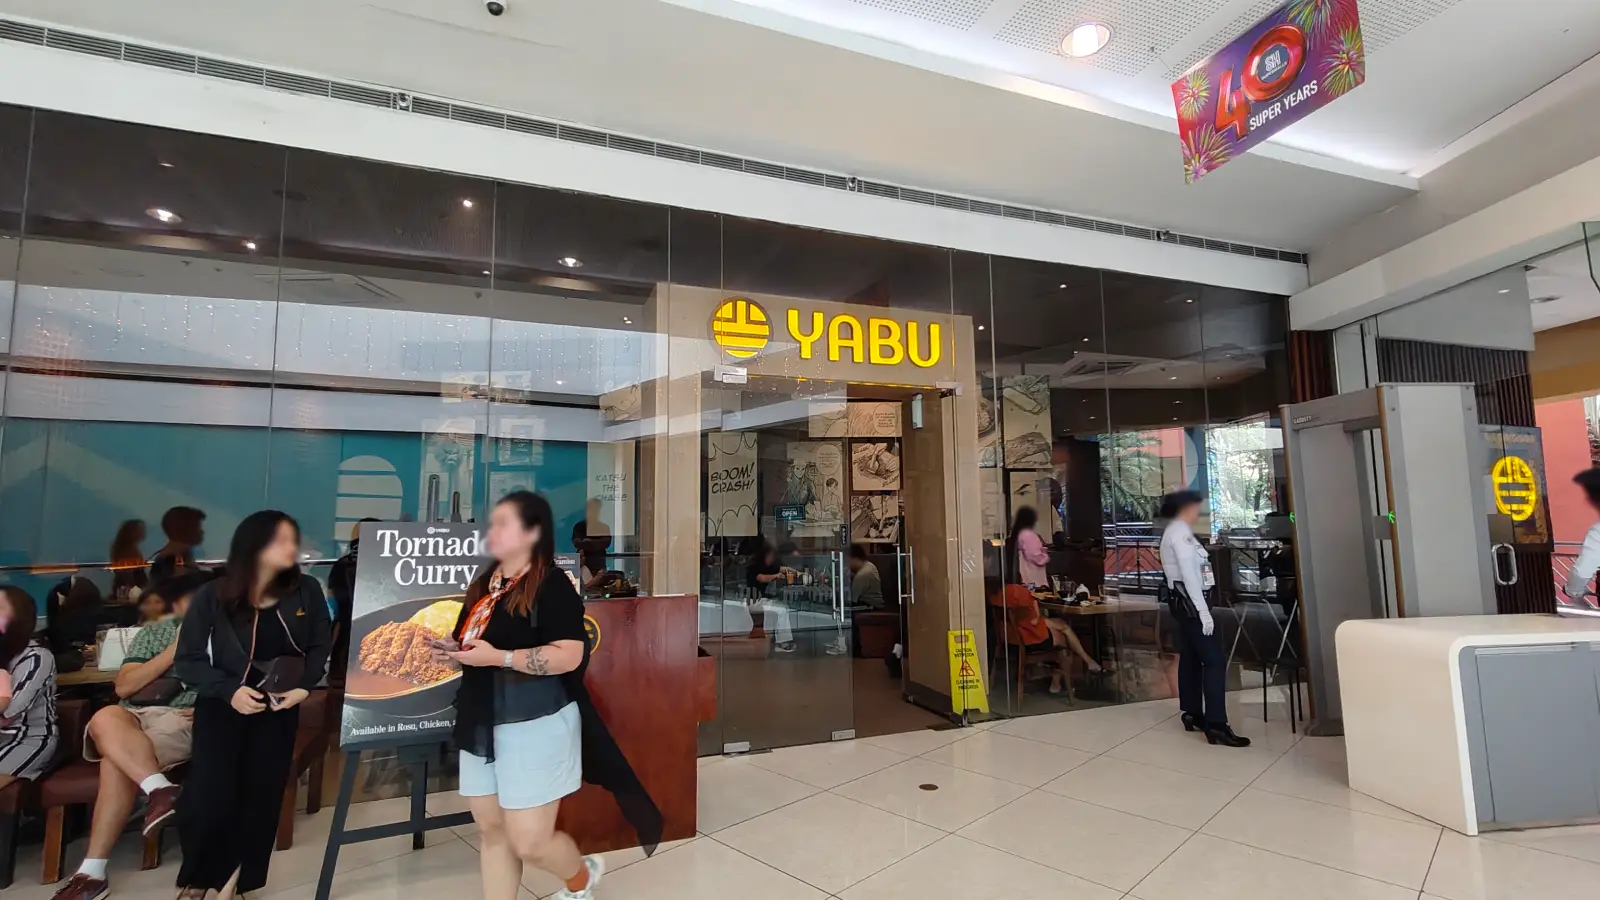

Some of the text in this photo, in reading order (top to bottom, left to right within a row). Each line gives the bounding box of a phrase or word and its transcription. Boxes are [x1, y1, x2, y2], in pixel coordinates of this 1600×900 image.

[1249, 79, 1318, 131] SUPER YEARS
[786, 308, 942, 368] YABU
[595, 473, 627, 483] KATSU
[711, 461, 755, 481] BOOM!
[602, 484, 621, 492] THE
[711, 479, 755, 494] CRASH!
[394, 558, 479, 591] Curry
[350, 724, 387, 737] Available
[388, 724, 397, 733] in
[419, 718, 452, 729] Chicken,
